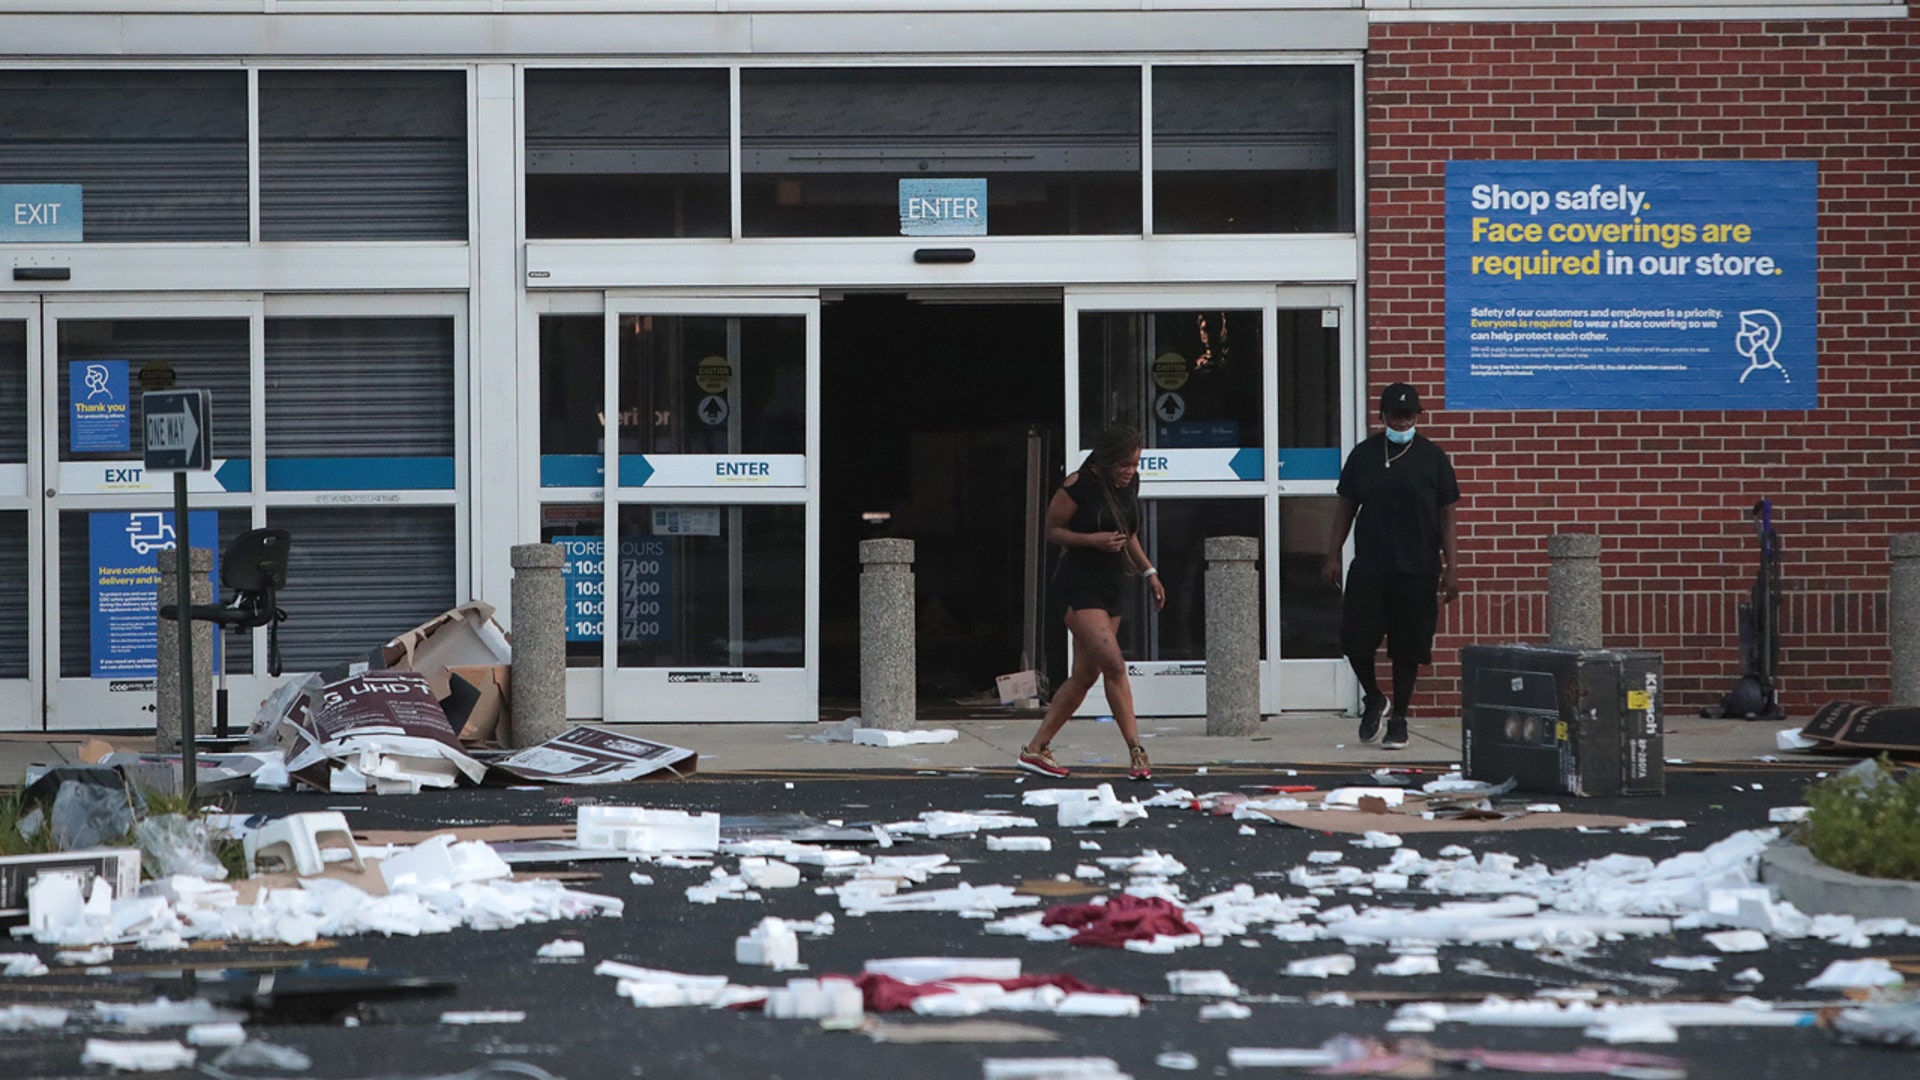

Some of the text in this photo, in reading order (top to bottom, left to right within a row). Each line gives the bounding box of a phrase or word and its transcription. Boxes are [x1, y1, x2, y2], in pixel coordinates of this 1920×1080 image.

[1471, 184, 1651, 215] Shop safely.
[14, 203, 61, 225] EXIT
[908, 197, 979, 219] ENTER
[1471, 217, 1751, 248] Face coverings are
[1471, 250, 1783, 280] required in our store.
[1471, 308, 1503, 319] Safety
[1505, 308, 1516, 317] of
[1516, 309, 1534, 317] our
[1535, 309, 1589, 317] customers
[1590, 308, 1609, 317] and
[1610, 308, 1665, 319] employees
[1666, 308, 1675, 317] is
[1684, 308, 1723, 319] priority.
[1471, 319, 1517, 329] Everyone
[1519, 319, 1528, 328] is
[1529, 319, 1572, 329] required
[1573, 320, 1584, 328] to
[1619, 319, 1641, 328] face
[1643, 319, 1687, 330] covering
[1471, 331, 1608, 342] can help protect each other.
[698, 367, 729, 375] CAUTION
[75, 402, 126, 414] Thank you
[148, 418, 165, 446] ONE
[167, 417, 185, 446] WAY
[716, 462, 769, 476] ENTER
[1140, 457, 1168, 470] TER
[105, 469, 143, 483] EXIT
[618, 541, 664, 556] OURS
[98, 566, 160, 575] Have confide
[575, 561, 604, 575] 10:0
[98, 576, 134, 586] delivery
[136, 575, 153, 584] and
[575, 581, 604, 595] 10:0
[575, 601, 604, 615] 10:0
[575, 622, 604, 635] 10:0
[323, 683, 431, 705] G UHD T
[1645, 673, 1657, 734] Klisch
